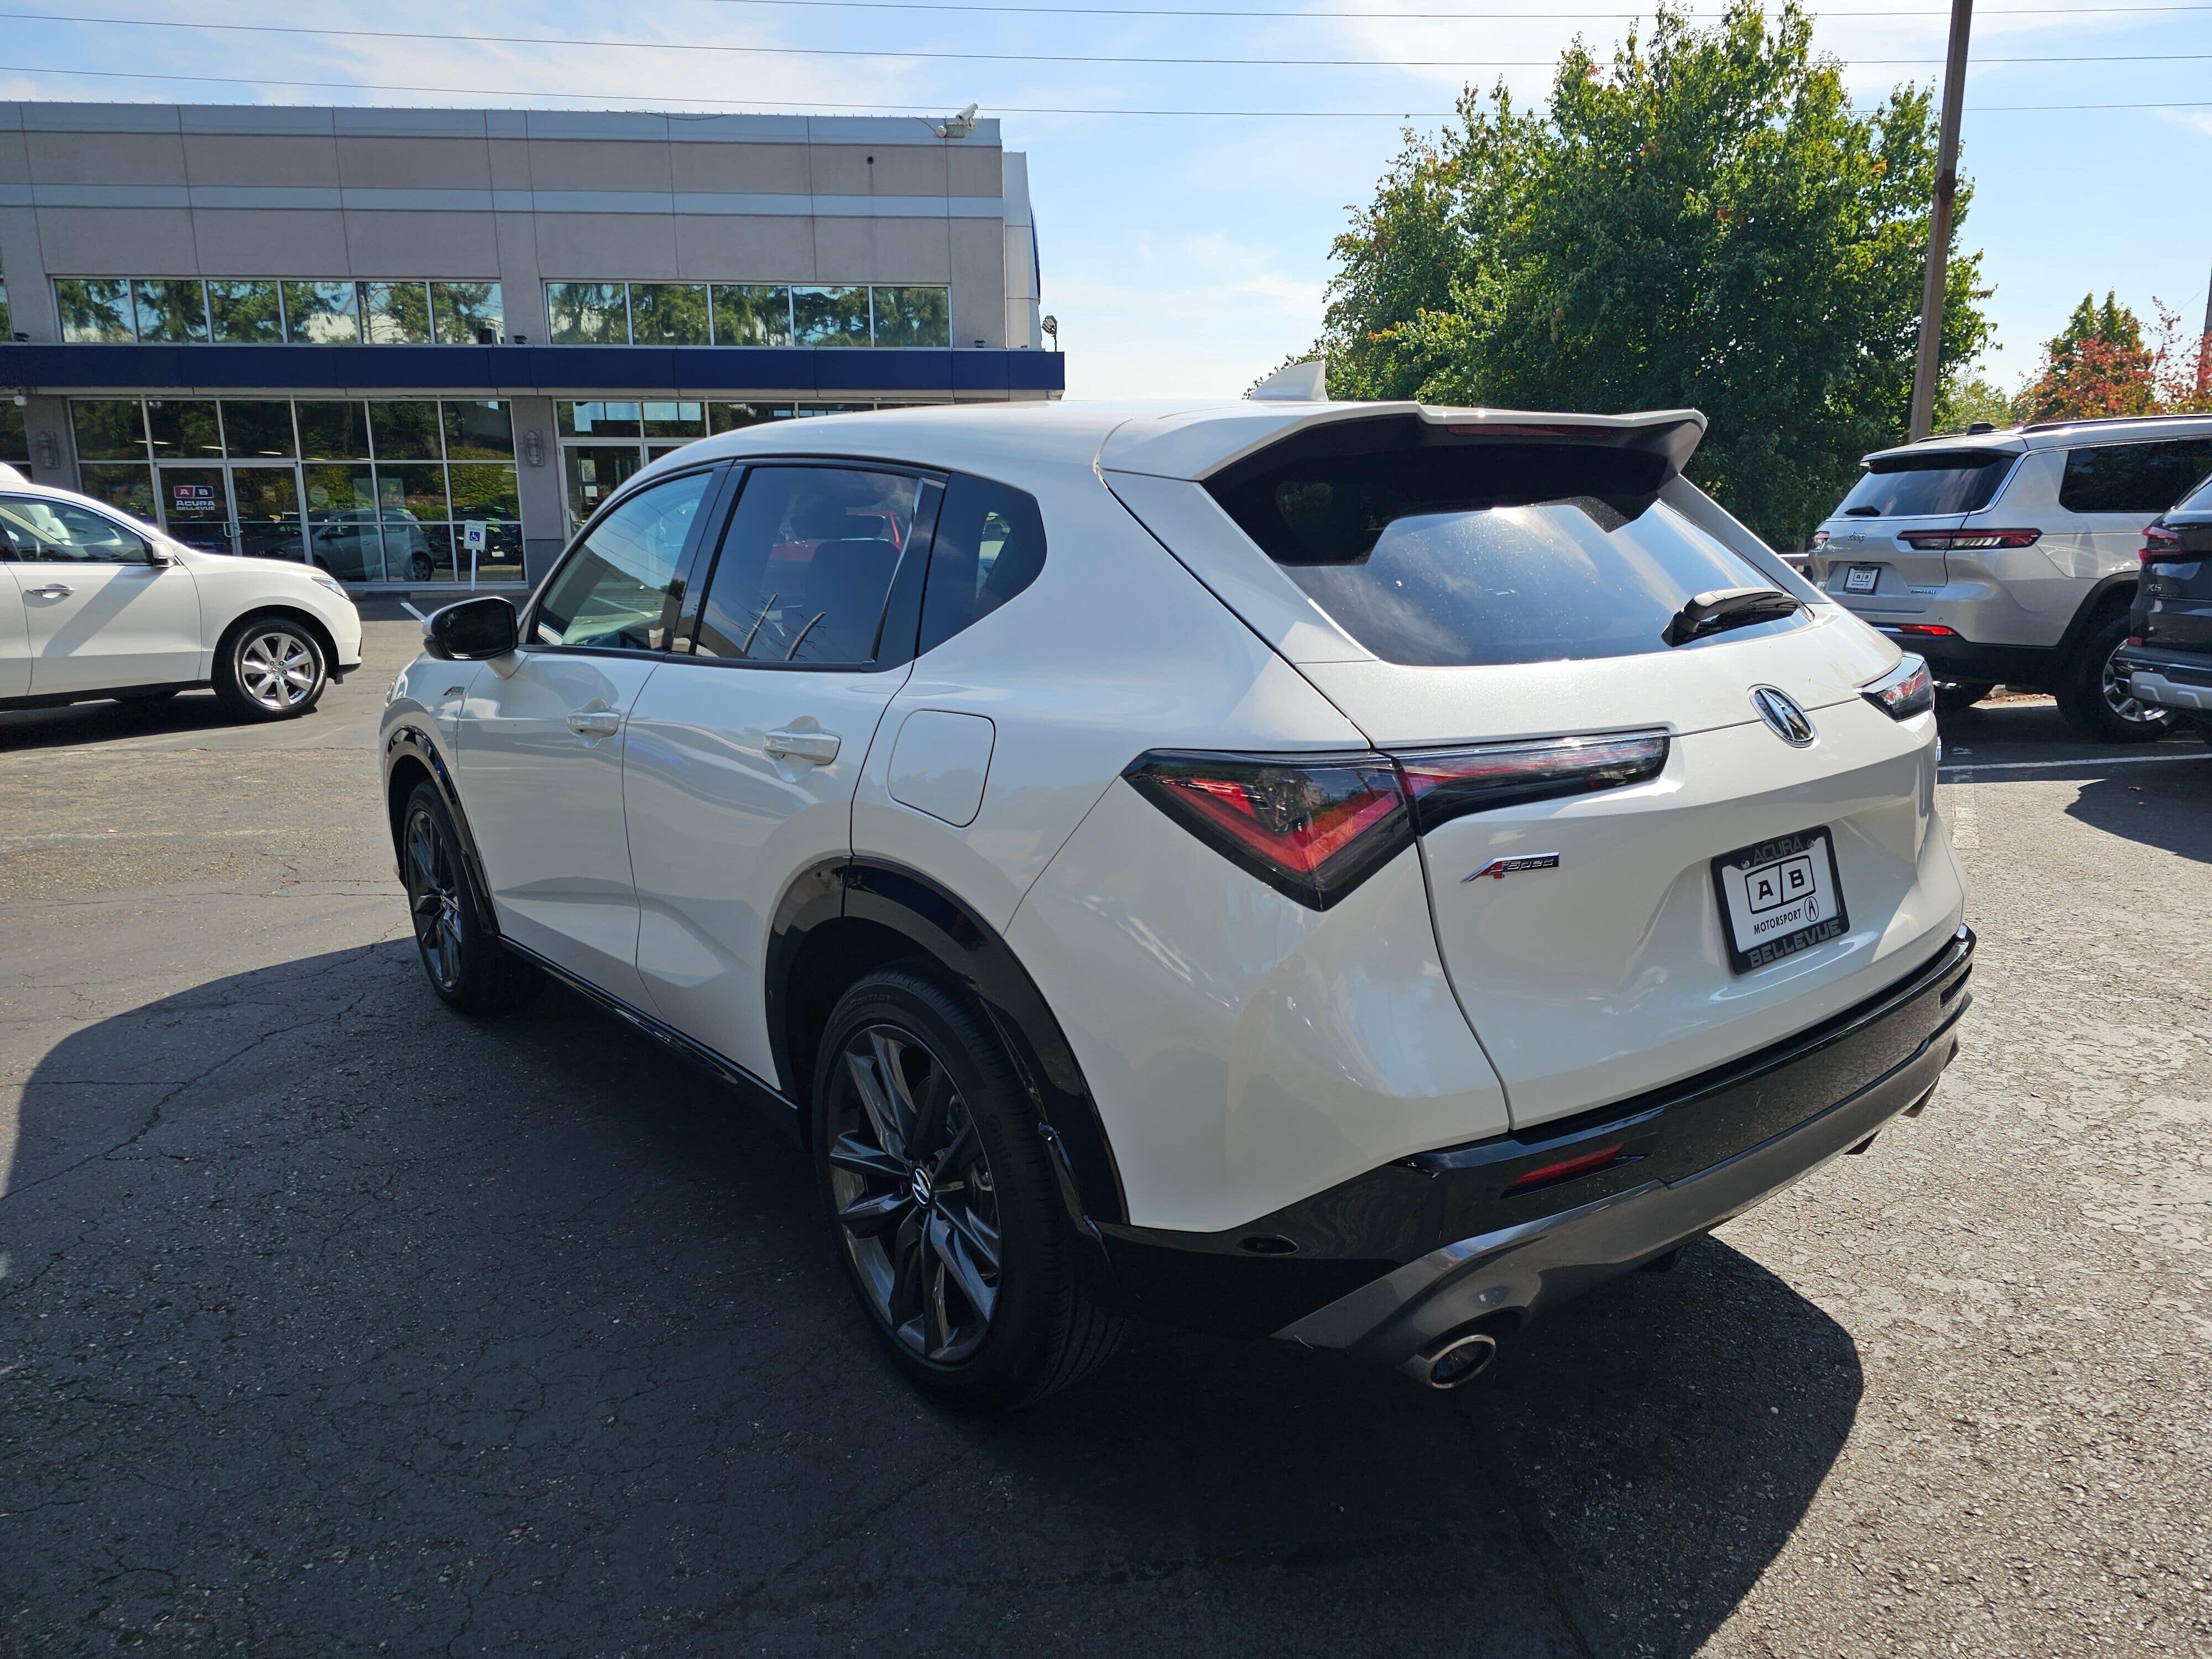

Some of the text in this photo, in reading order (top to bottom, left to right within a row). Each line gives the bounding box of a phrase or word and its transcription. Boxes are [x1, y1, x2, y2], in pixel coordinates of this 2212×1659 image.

[1752, 837, 1804, 865] ACURA
[1757, 869, 1805, 900] A B
[1754, 908, 1801, 935] MOTORSPORT
[1747, 919, 1841, 968] BELLEVUE
